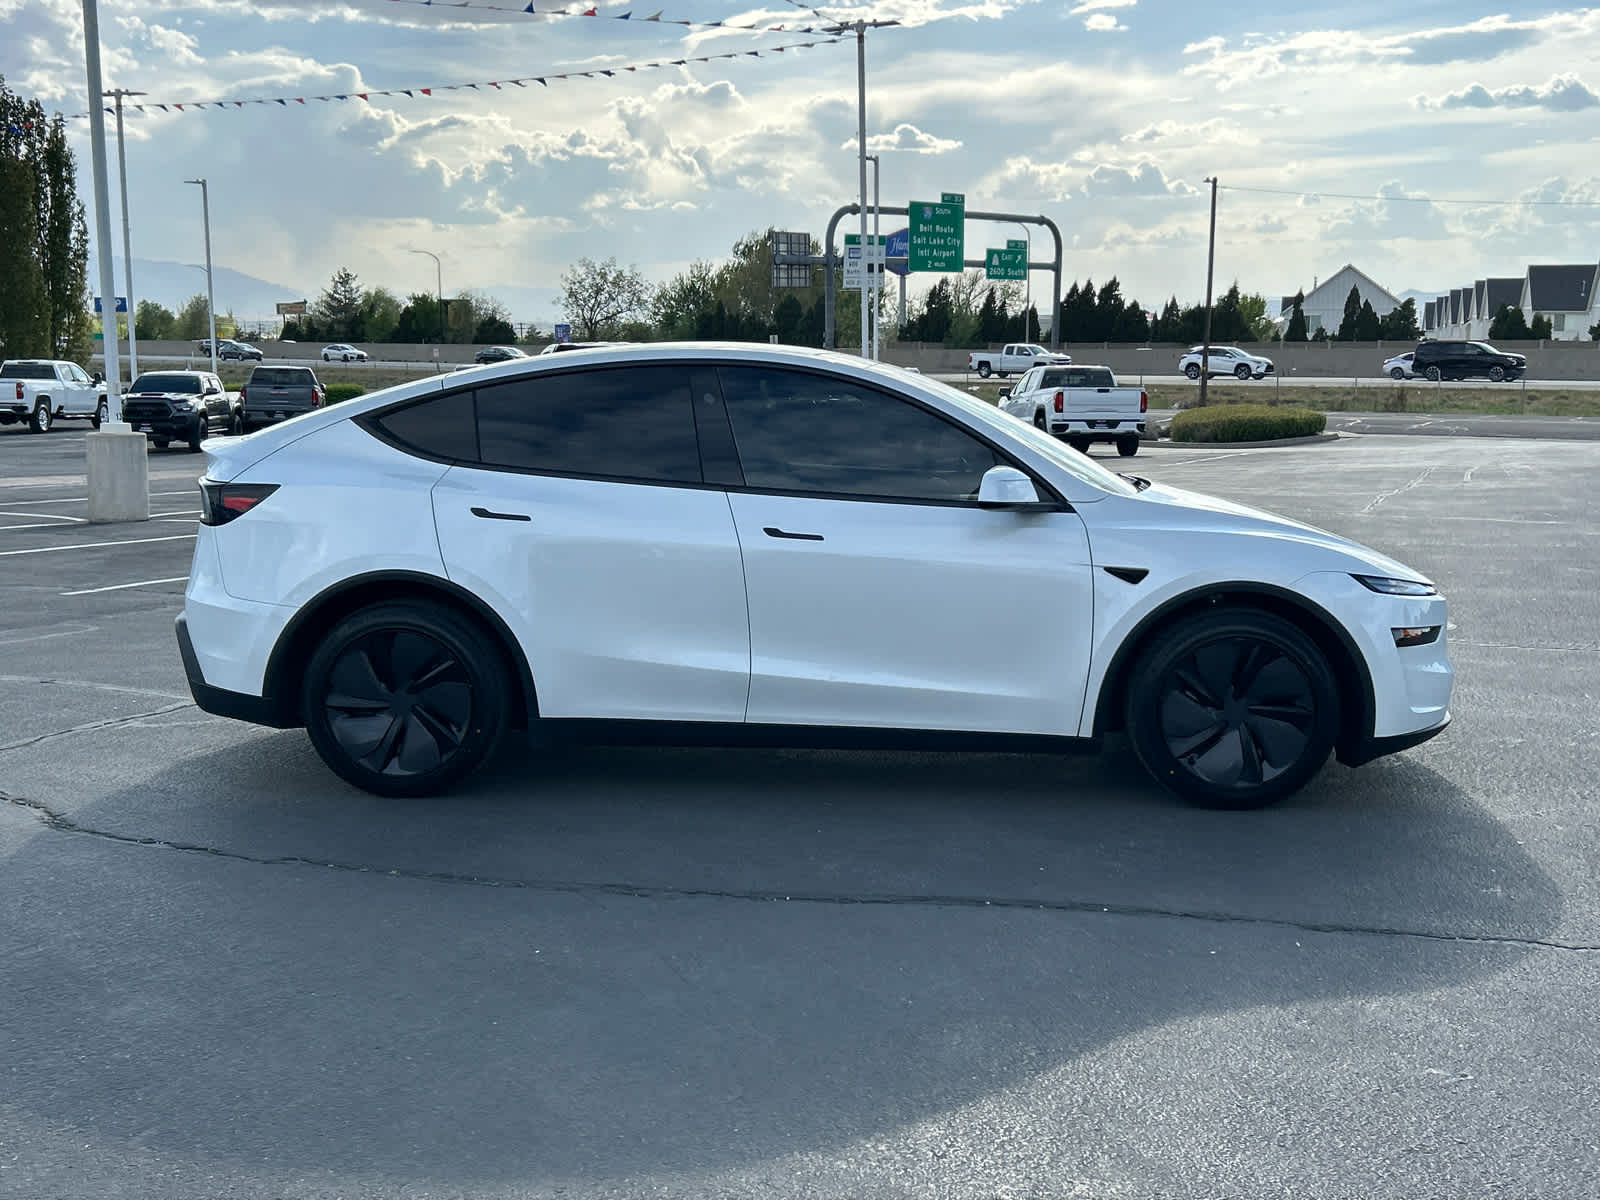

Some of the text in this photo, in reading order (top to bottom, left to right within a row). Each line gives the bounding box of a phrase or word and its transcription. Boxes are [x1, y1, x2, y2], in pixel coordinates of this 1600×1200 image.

[920, 224, 954, 233] Belt Route
[913, 236, 960, 247] Salt Lake City
[932, 249, 955, 259] Airport
[1007, 268, 1024, 276] South
